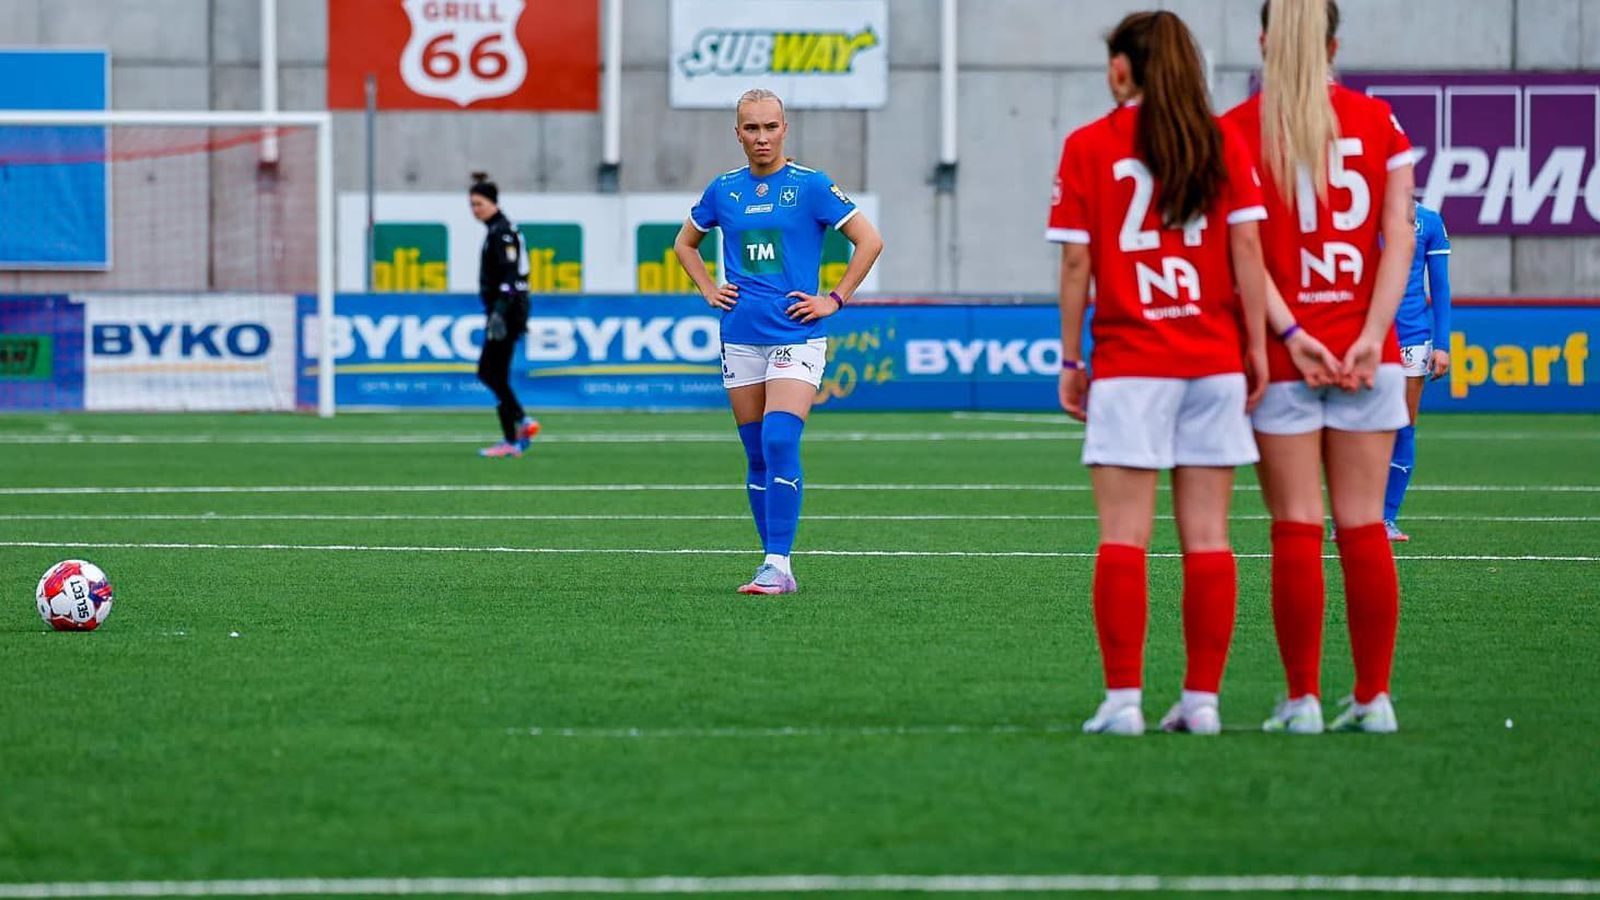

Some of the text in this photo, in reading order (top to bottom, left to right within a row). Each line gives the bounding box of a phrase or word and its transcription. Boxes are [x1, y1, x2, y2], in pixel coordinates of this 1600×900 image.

[421, 33, 508, 80] 66
[677, 24, 880, 77] SUBWAY
[1411, 146, 1600, 225] PM
[746, 243, 775, 261] TM
[1300, 242, 1364, 288] NA
[1135, 256, 1201, 305] NA
[91, 323, 272, 358] BYKO
[525, 316, 720, 362] BYKO
[905, 338, 1063, 376] BYKO
[70, 580, 90, 619] SELECT
